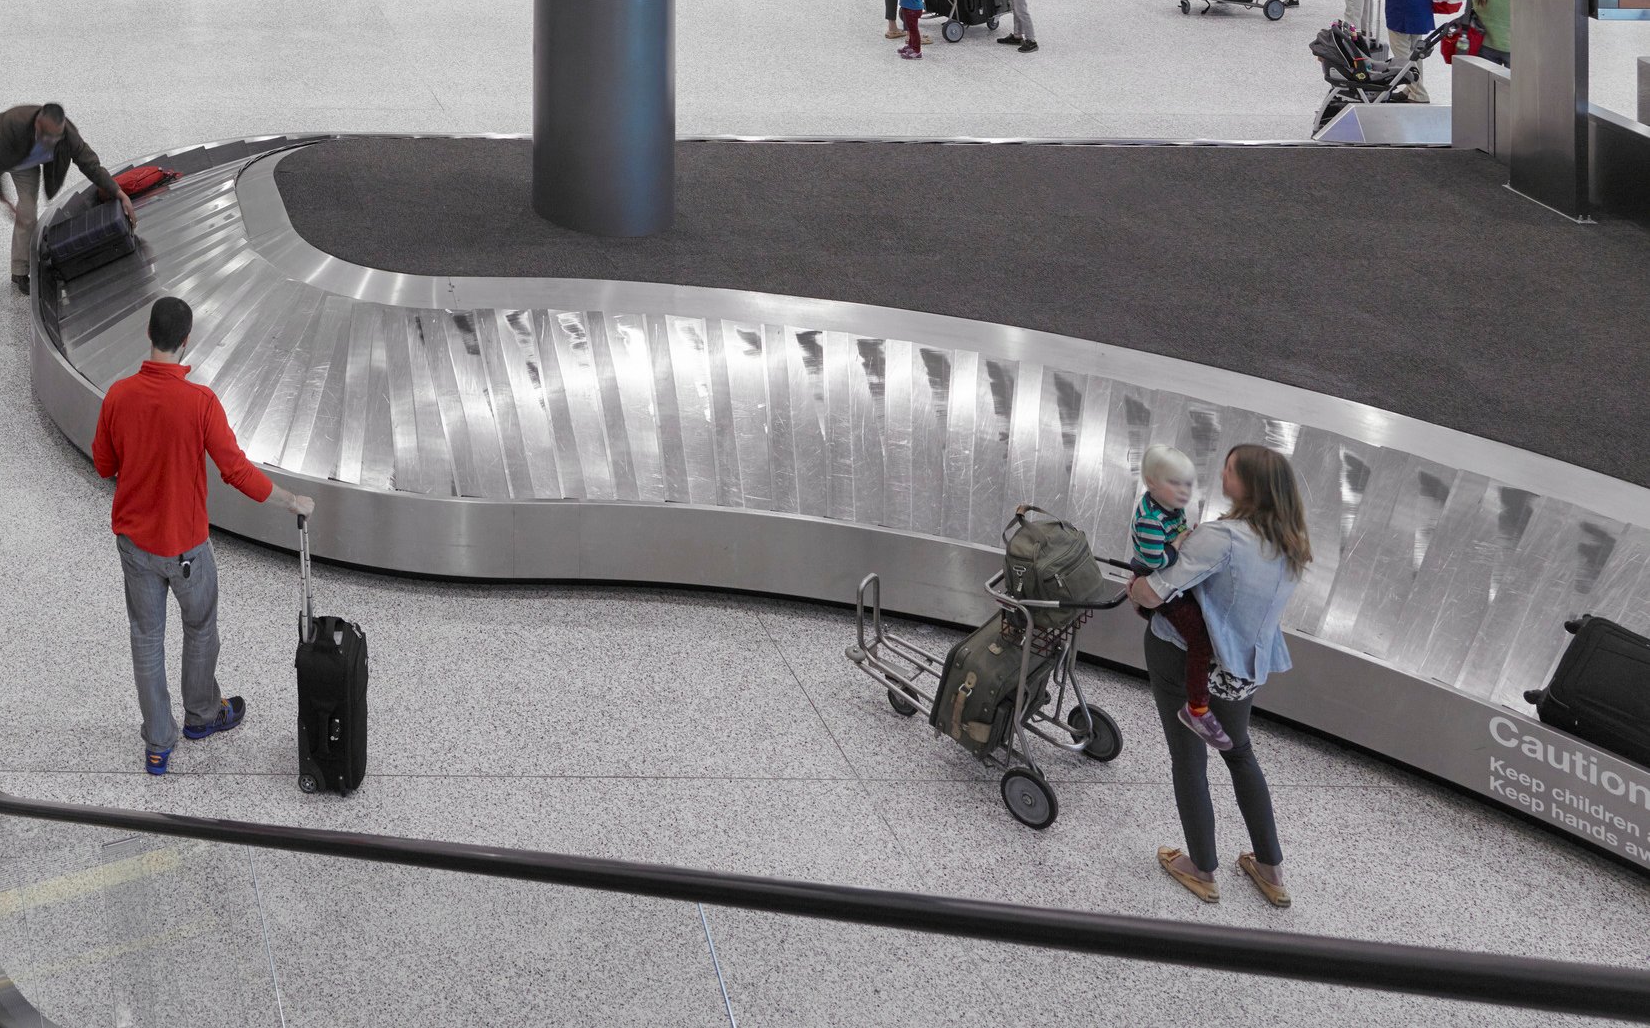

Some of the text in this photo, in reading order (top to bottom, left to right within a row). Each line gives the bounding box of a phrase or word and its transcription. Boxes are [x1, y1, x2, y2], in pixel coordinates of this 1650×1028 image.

[1489, 716, 1650, 810] Caution
[1490, 756, 1640, 837] Keep children
[1489, 776, 1544, 812] Keep
[1551, 803, 1618, 846] hands
